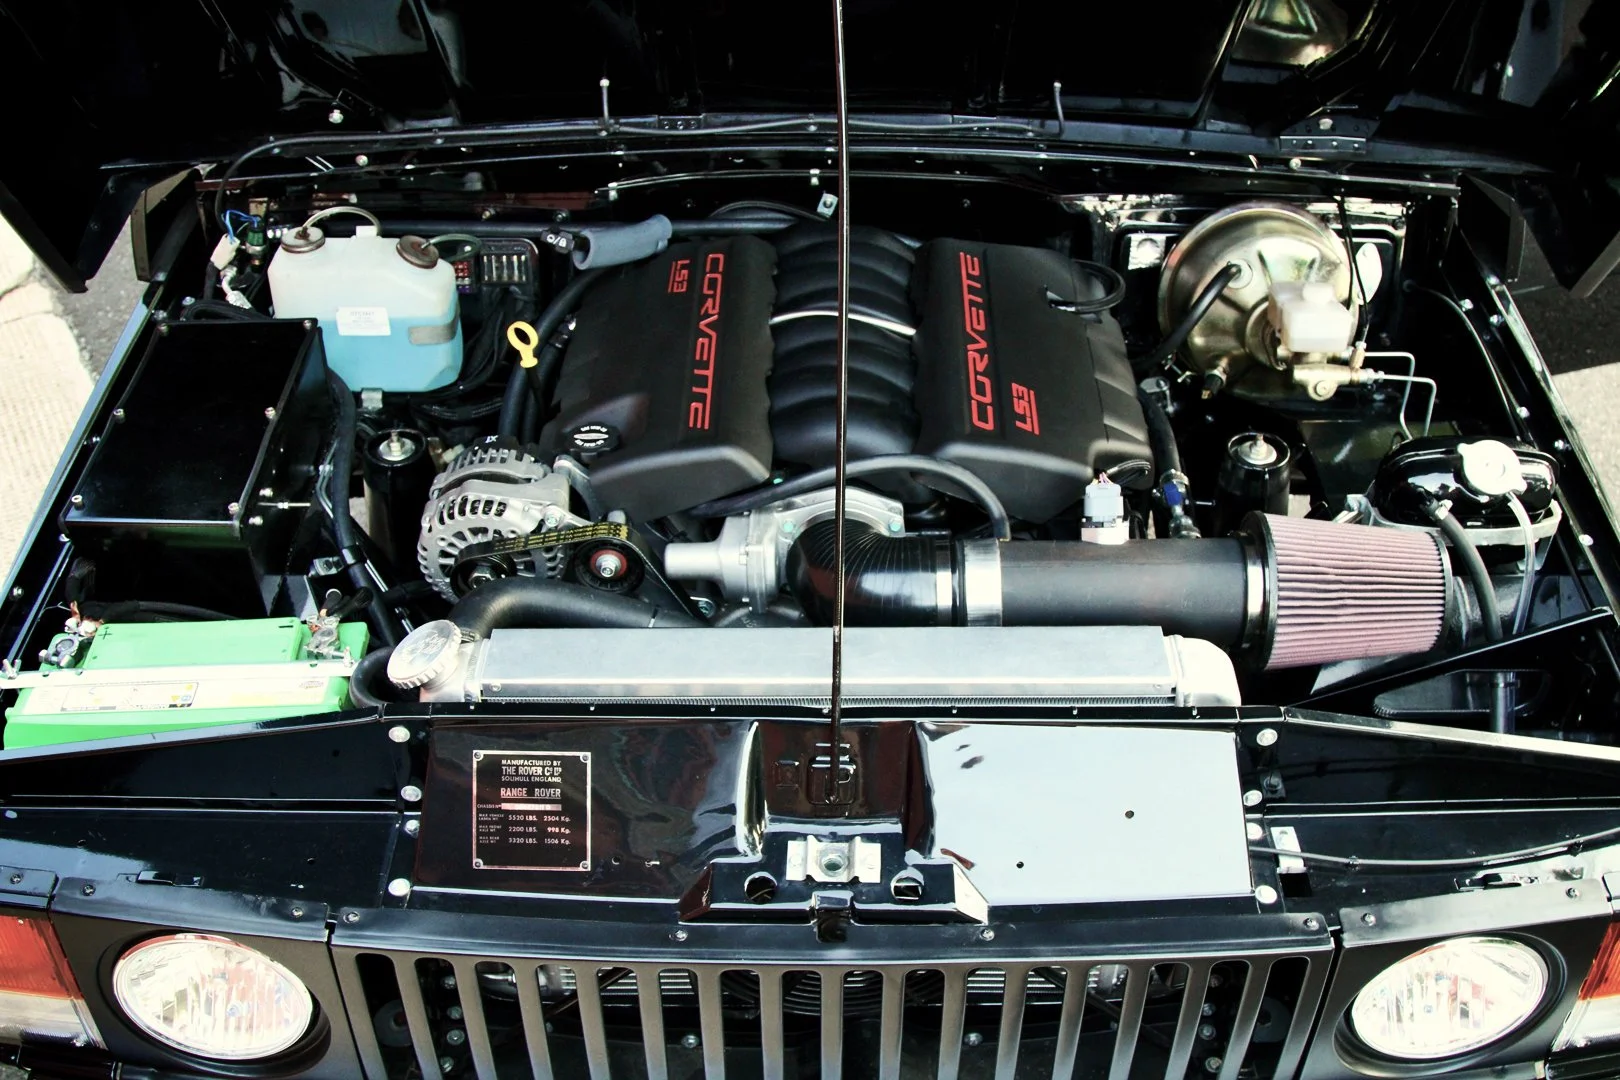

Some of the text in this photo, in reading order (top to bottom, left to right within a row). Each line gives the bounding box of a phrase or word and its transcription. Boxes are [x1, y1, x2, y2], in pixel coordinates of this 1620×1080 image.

[673, 259, 691, 293] LS3
[688, 253, 725, 430] CORVETTE
[959, 251, 994, 431] CORVETTE
[1011, 382, 1033, 432] LS3
[501, 766, 516, 775] THE
[518, 766, 543, 776] ROVER
[500, 788, 561, 798] RANGE ROVER
